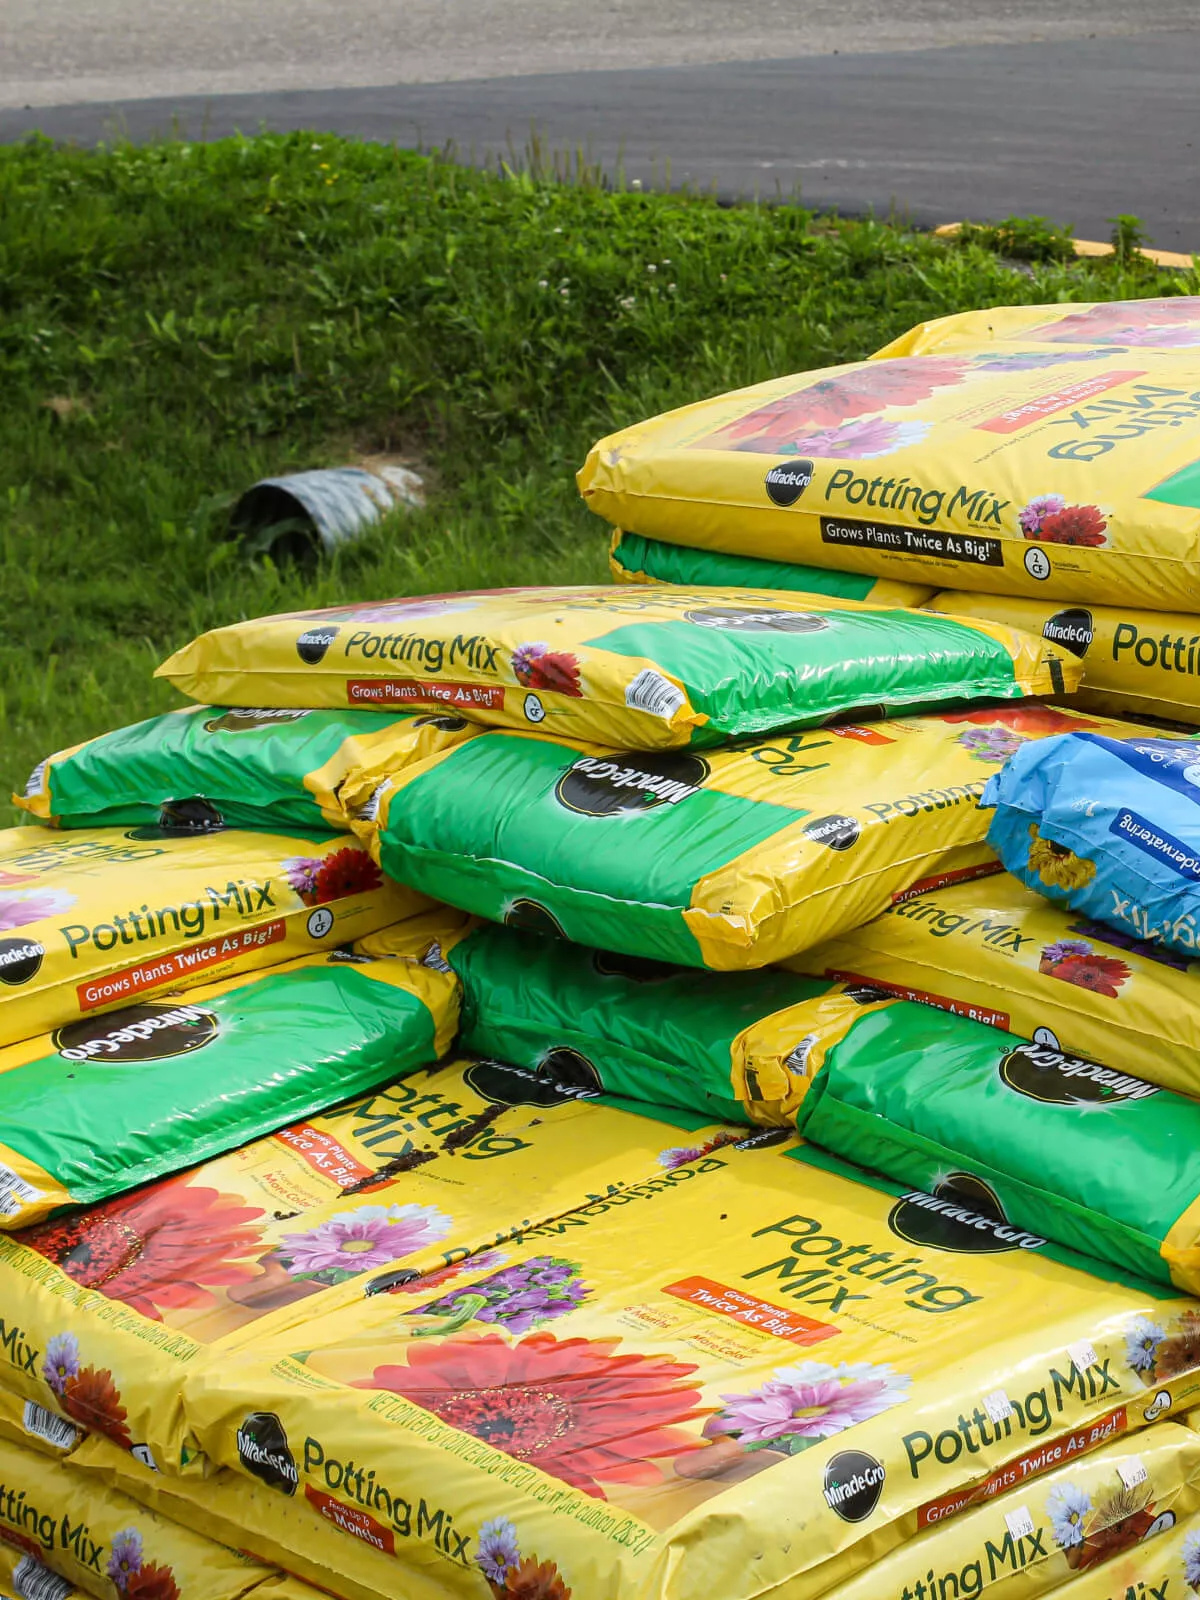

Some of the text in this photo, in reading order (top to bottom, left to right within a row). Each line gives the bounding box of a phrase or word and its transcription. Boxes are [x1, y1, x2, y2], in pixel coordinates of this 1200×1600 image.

[1047, 384, 1189, 429] Mix
[825, 469, 946, 525] Potting
[947, 486, 1011, 525] Mix
[826, 523, 864, 541] Grows
[866, 528, 902, 546] Plants
[903, 531, 943, 551] Twice
[946, 539, 963, 554] As
[964, 542, 992, 561] Big!
[1033, 553, 1041, 564] 2
[1031, 563, 1044, 575] CF
[345, 631, 501, 673] Potting Mix
[1043, 620, 1094, 645] Miracle-Gro
[351, 685, 385, 700] Grows
[385, 684, 417, 700] Plants
[454, 687, 472, 703] As
[473, 689, 494, 707] Big!
[529, 707, 540, 719] CF
[570, 755, 701, 804] Miracle-Gro
[60, 878, 278, 959] Potting Mix
[313, 921, 327, 932] CF
[316, 911, 324, 923] 1
[973, 917, 1036, 954] Mix
[85, 925, 273, 1001] Grows Plants Twice As Big!
[60, 1004, 215, 1060] Miracle-Gro
[1017, 1042, 1160, 1100] Miracle-Gro
[302, 1127, 357, 1171] Grows Plants
[311, 1150, 333, 1169] As
[900, 1189, 1048, 1250] Miracle-Gro
[740, 1214, 984, 1314] Potting Mix
[691, 1288, 803, 1337] Twice As Big!
[724, 1289, 792, 1320] Grows Plants
[0, 1318, 39, 1378] Mix
[691, 1333, 719, 1351] More
[1049, 1357, 1121, 1413] Mix
[822, 1465, 886, 1510] Miracle-Gro
[925, 1416, 1120, 1524] Grows Twice As Big!
[236, 1430, 472, 1566] Miracle-Gro Potting Mix
[60, 1513, 104, 1572] Mix
[321, 1504, 385, 1552] 6 Months
[983, 1525, 1049, 1580] Mix
